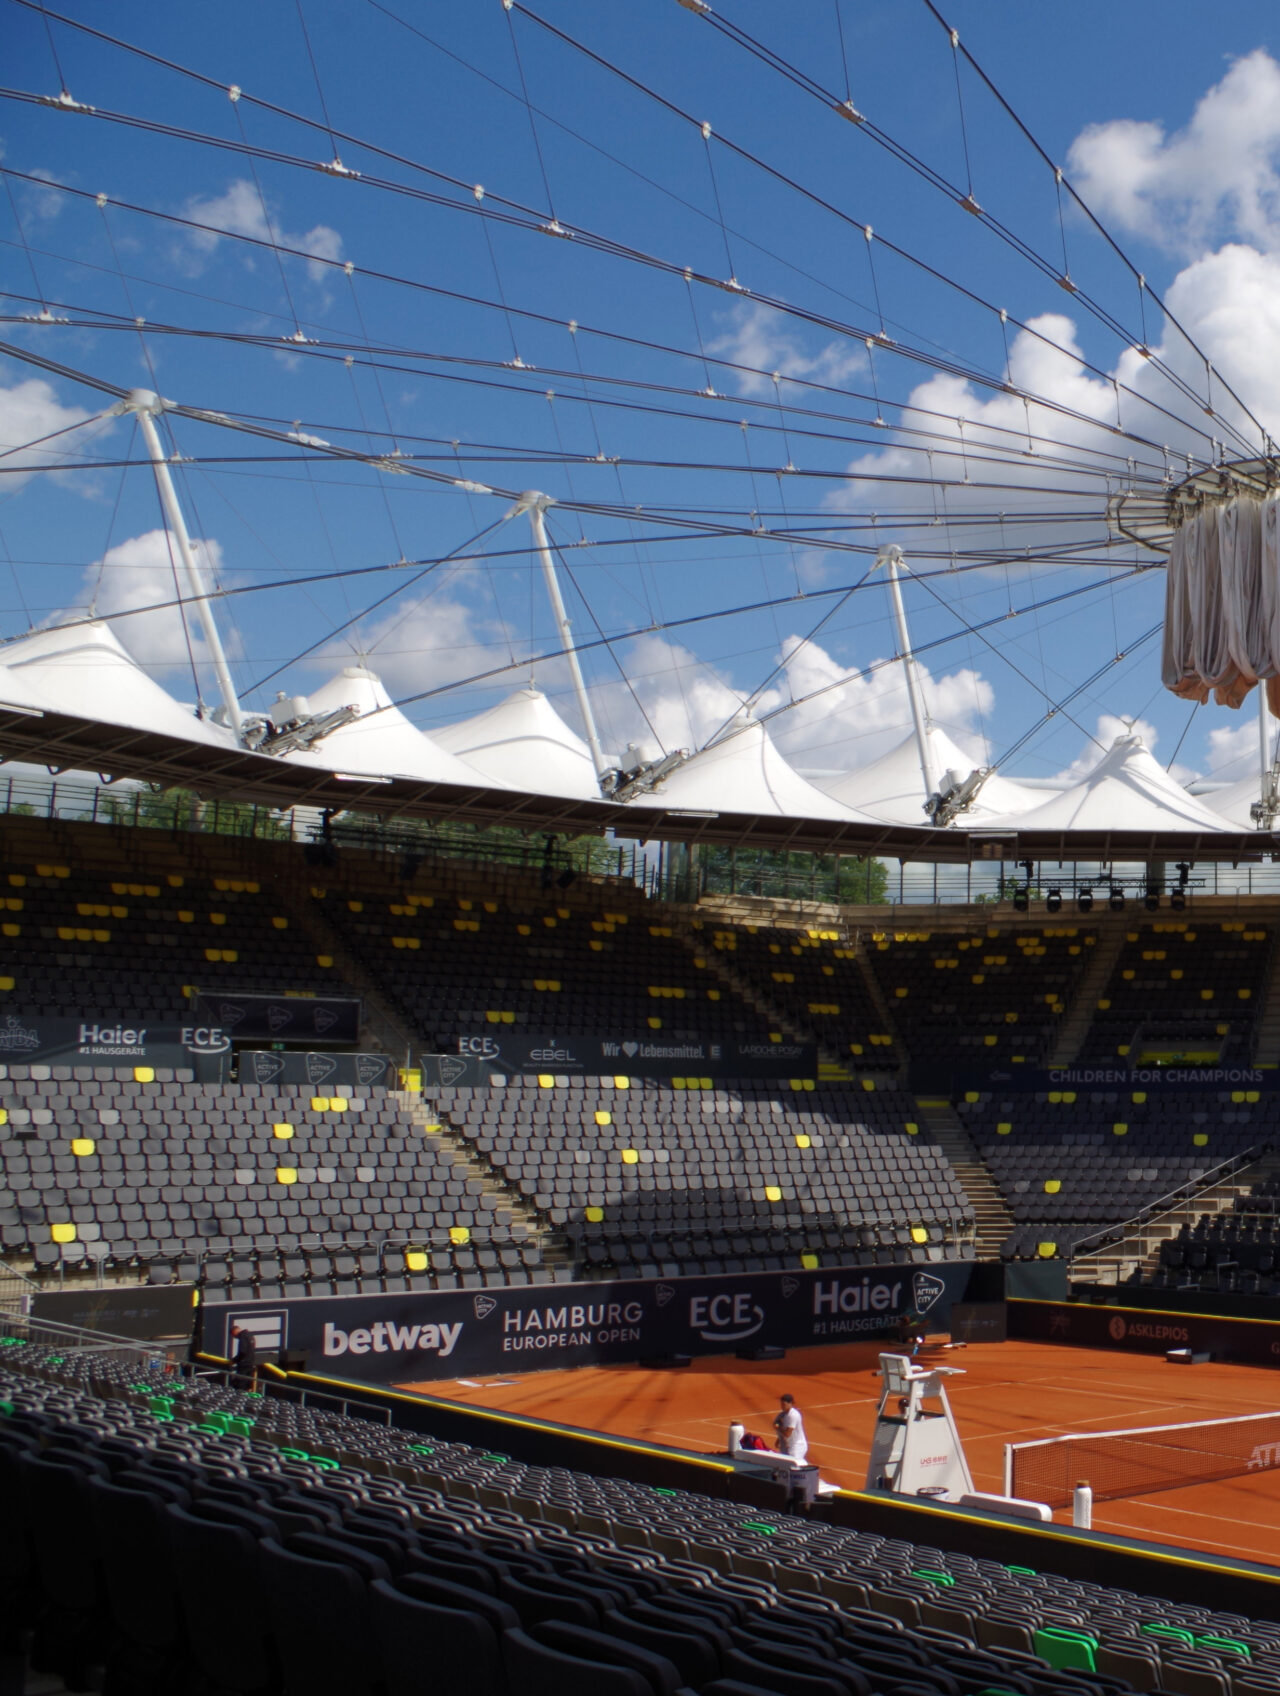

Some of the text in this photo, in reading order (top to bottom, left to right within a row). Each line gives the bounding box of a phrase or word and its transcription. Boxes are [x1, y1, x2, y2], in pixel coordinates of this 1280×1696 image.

[79, 1024, 147, 1045] Haier
[181, 1027, 223, 1046] ECE
[459, 1037, 494, 1053] ECE
[601, 1042, 621, 1058] Wir
[1049, 1069, 1264, 1083] CHILDREN FOR CHAMPIONS
[812, 1276, 903, 1316] Haier
[916, 1286, 940, 1297] ACTIVE
[916, 1295, 933, 1304] CITY
[503, 1301, 645, 1333] HAMBURG
[690, 1293, 752, 1328] ECE
[812, 1321, 828, 1335] #1
[1128, 1324, 1189, 1342] ASKLEPIOS
[323, 1321, 464, 1357] betway
[503, 1327, 641, 1352] EUROPEAN OPEN
